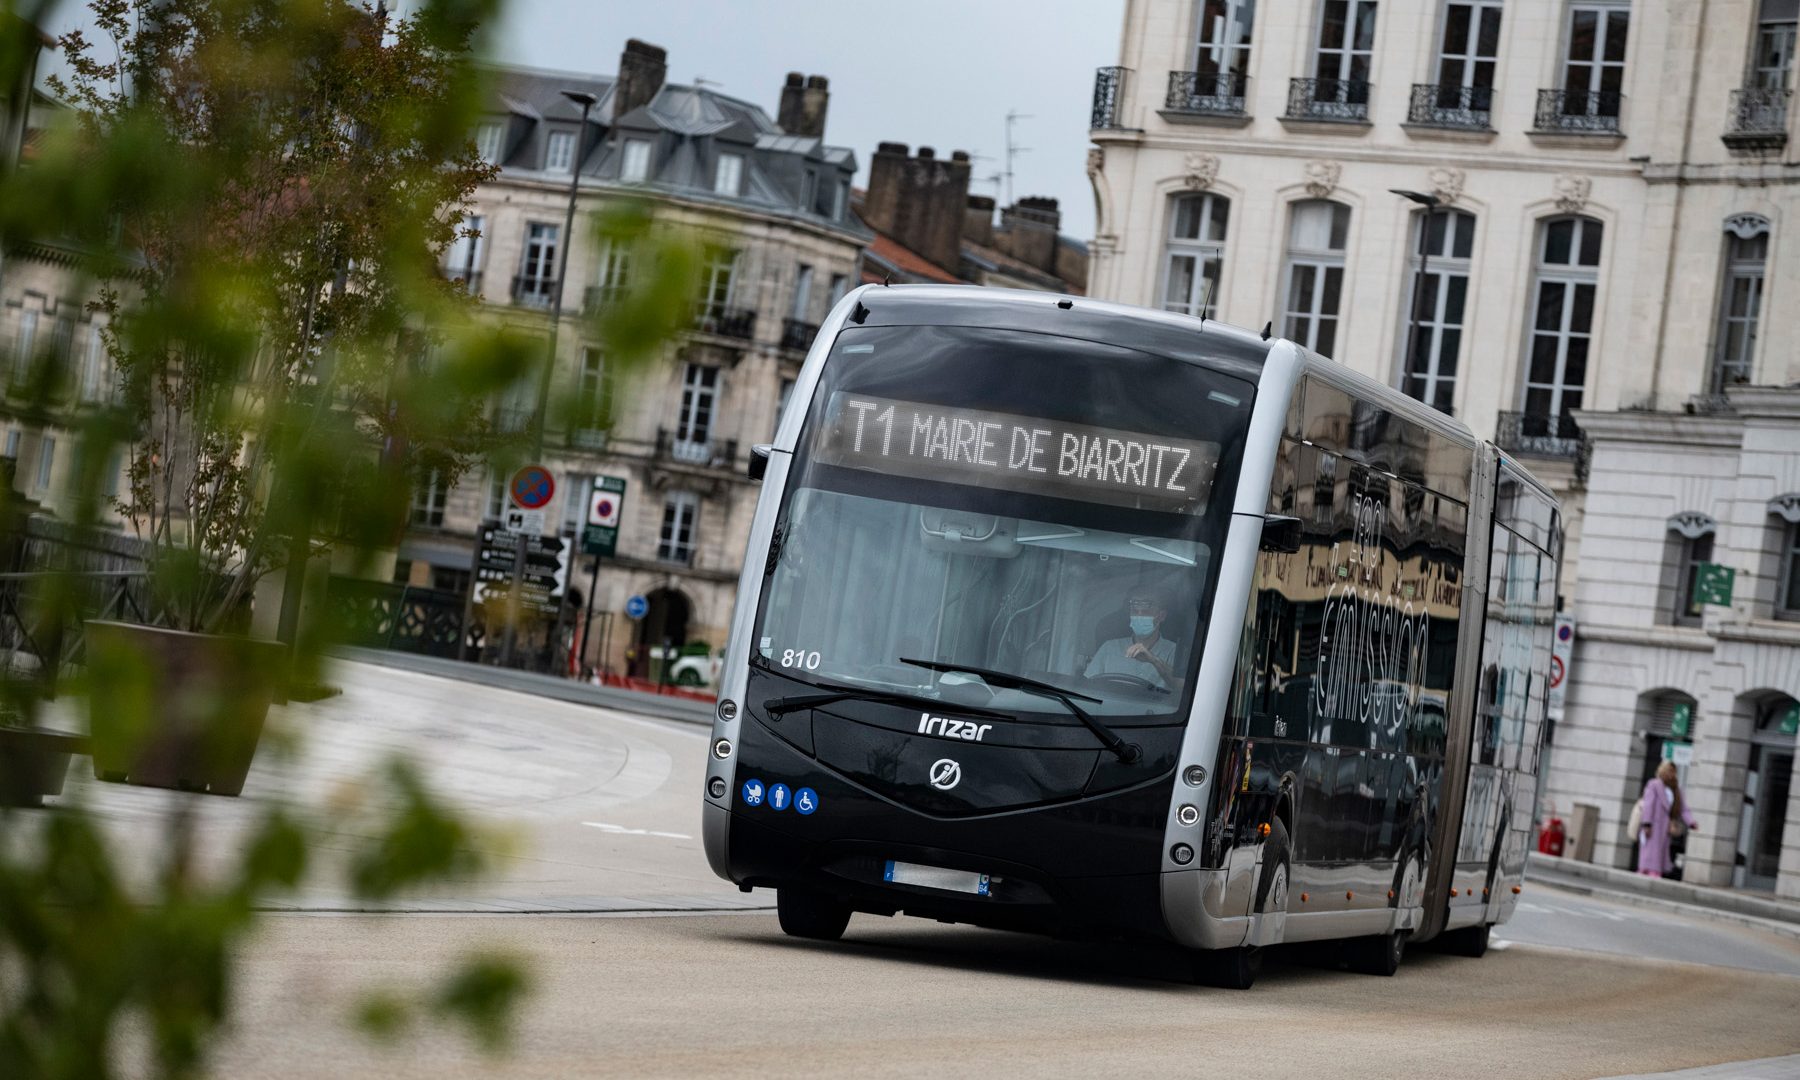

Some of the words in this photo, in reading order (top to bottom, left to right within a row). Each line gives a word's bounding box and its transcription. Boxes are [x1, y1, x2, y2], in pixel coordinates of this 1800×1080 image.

[849, 400, 895, 456] T1
[909, 413, 1002, 467] MAIRIE
[1008, 426, 1052, 474] DE
[1057, 433, 1191, 492] BIARRITZ
[781, 648, 821, 670] 810
[917, 712, 993, 742] Irizar
